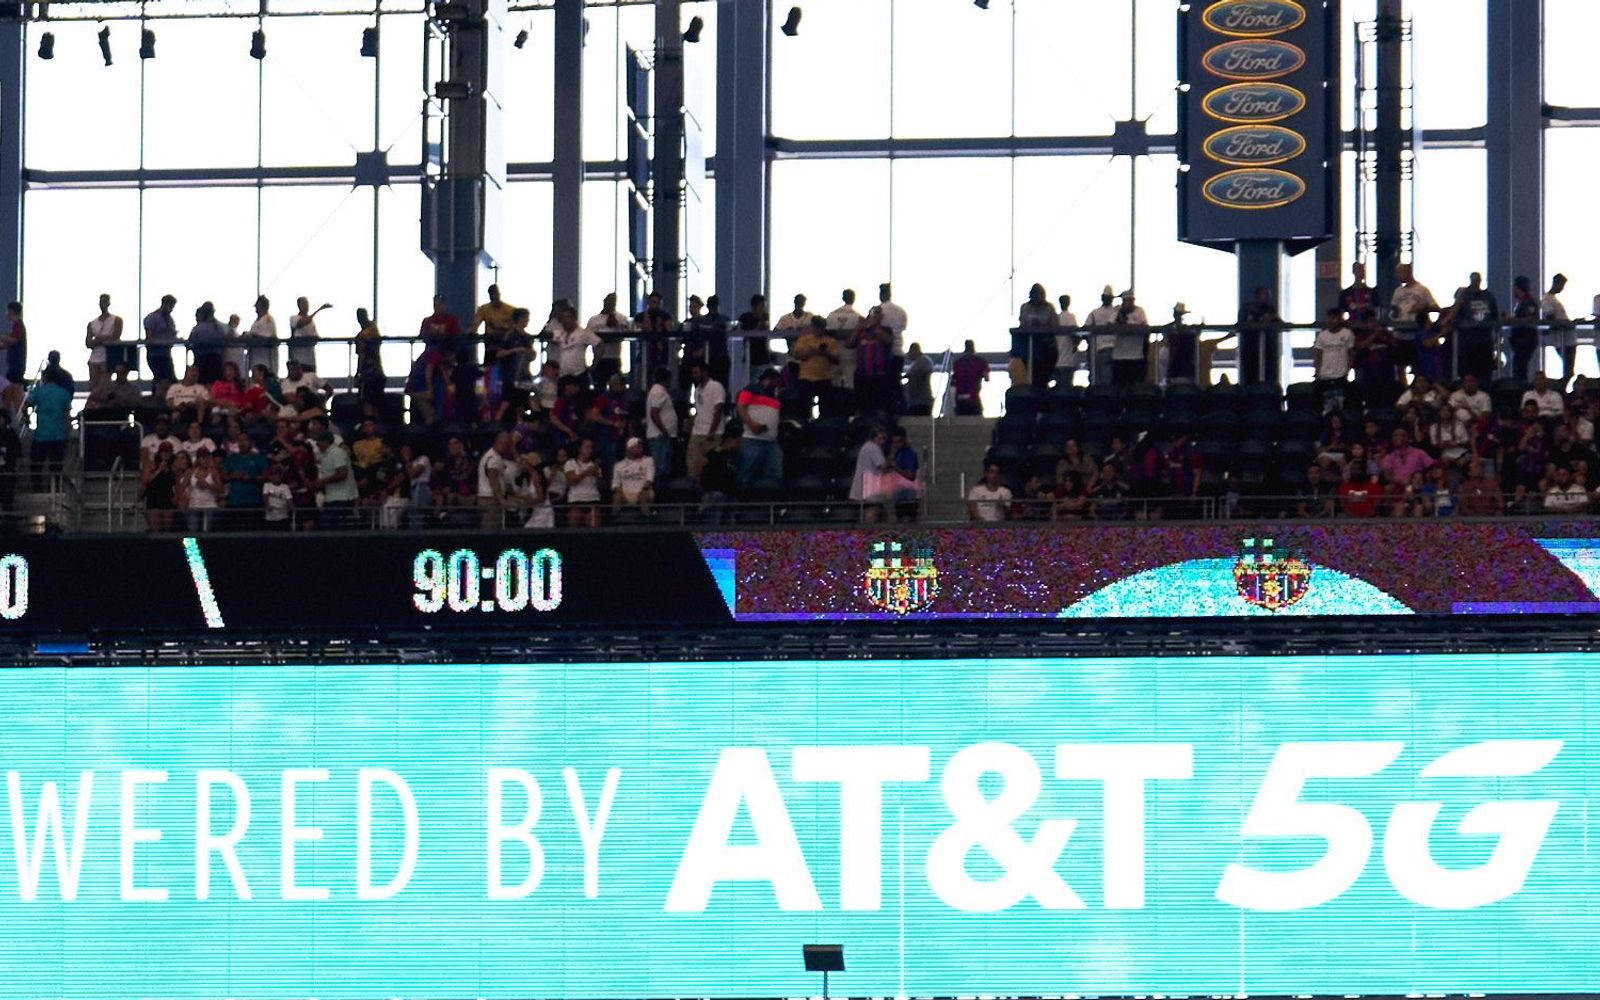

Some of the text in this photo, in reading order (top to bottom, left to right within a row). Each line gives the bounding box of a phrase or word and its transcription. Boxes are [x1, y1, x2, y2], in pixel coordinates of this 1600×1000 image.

[1225, 3, 1283, 27] Ford
[1224, 46, 1282, 70] Ford
[1224, 89, 1282, 114] Ford
[1225, 131, 1283, 156] Ford
[1226, 174, 1284, 199] Ford
[413, 548, 563, 615] 90:00
[488, 767, 620, 900] BY
[666, 741, 1191, 912] AT&T
[1217, 740, 1562, 911] 5G
